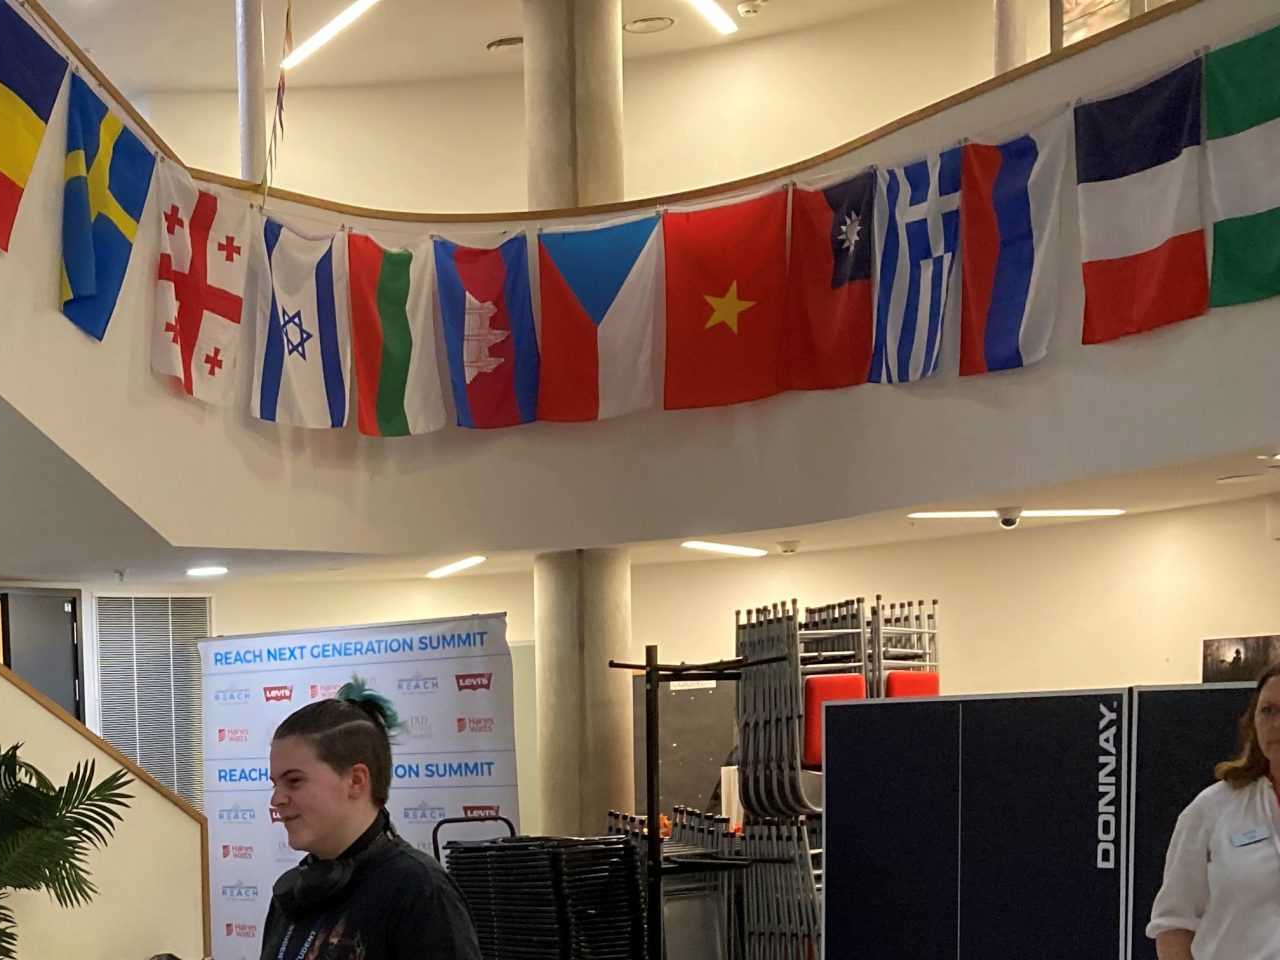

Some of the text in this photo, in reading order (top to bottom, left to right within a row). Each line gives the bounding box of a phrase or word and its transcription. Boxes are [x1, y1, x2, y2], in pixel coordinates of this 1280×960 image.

[214, 631, 488, 666] REACH NEXT GENERATION SUMMIT
[397, 681, 439, 691] REACH
[214, 693, 251, 701] REACH
[218, 767, 269, 783] REACH
[425, 762, 495, 778] SUMMIT
[1096, 702, 1117, 869] DONNAY
[218, 812, 256, 820] REACH
[403, 810, 446, 819] REACH
[222, 889, 258, 897] REACH
